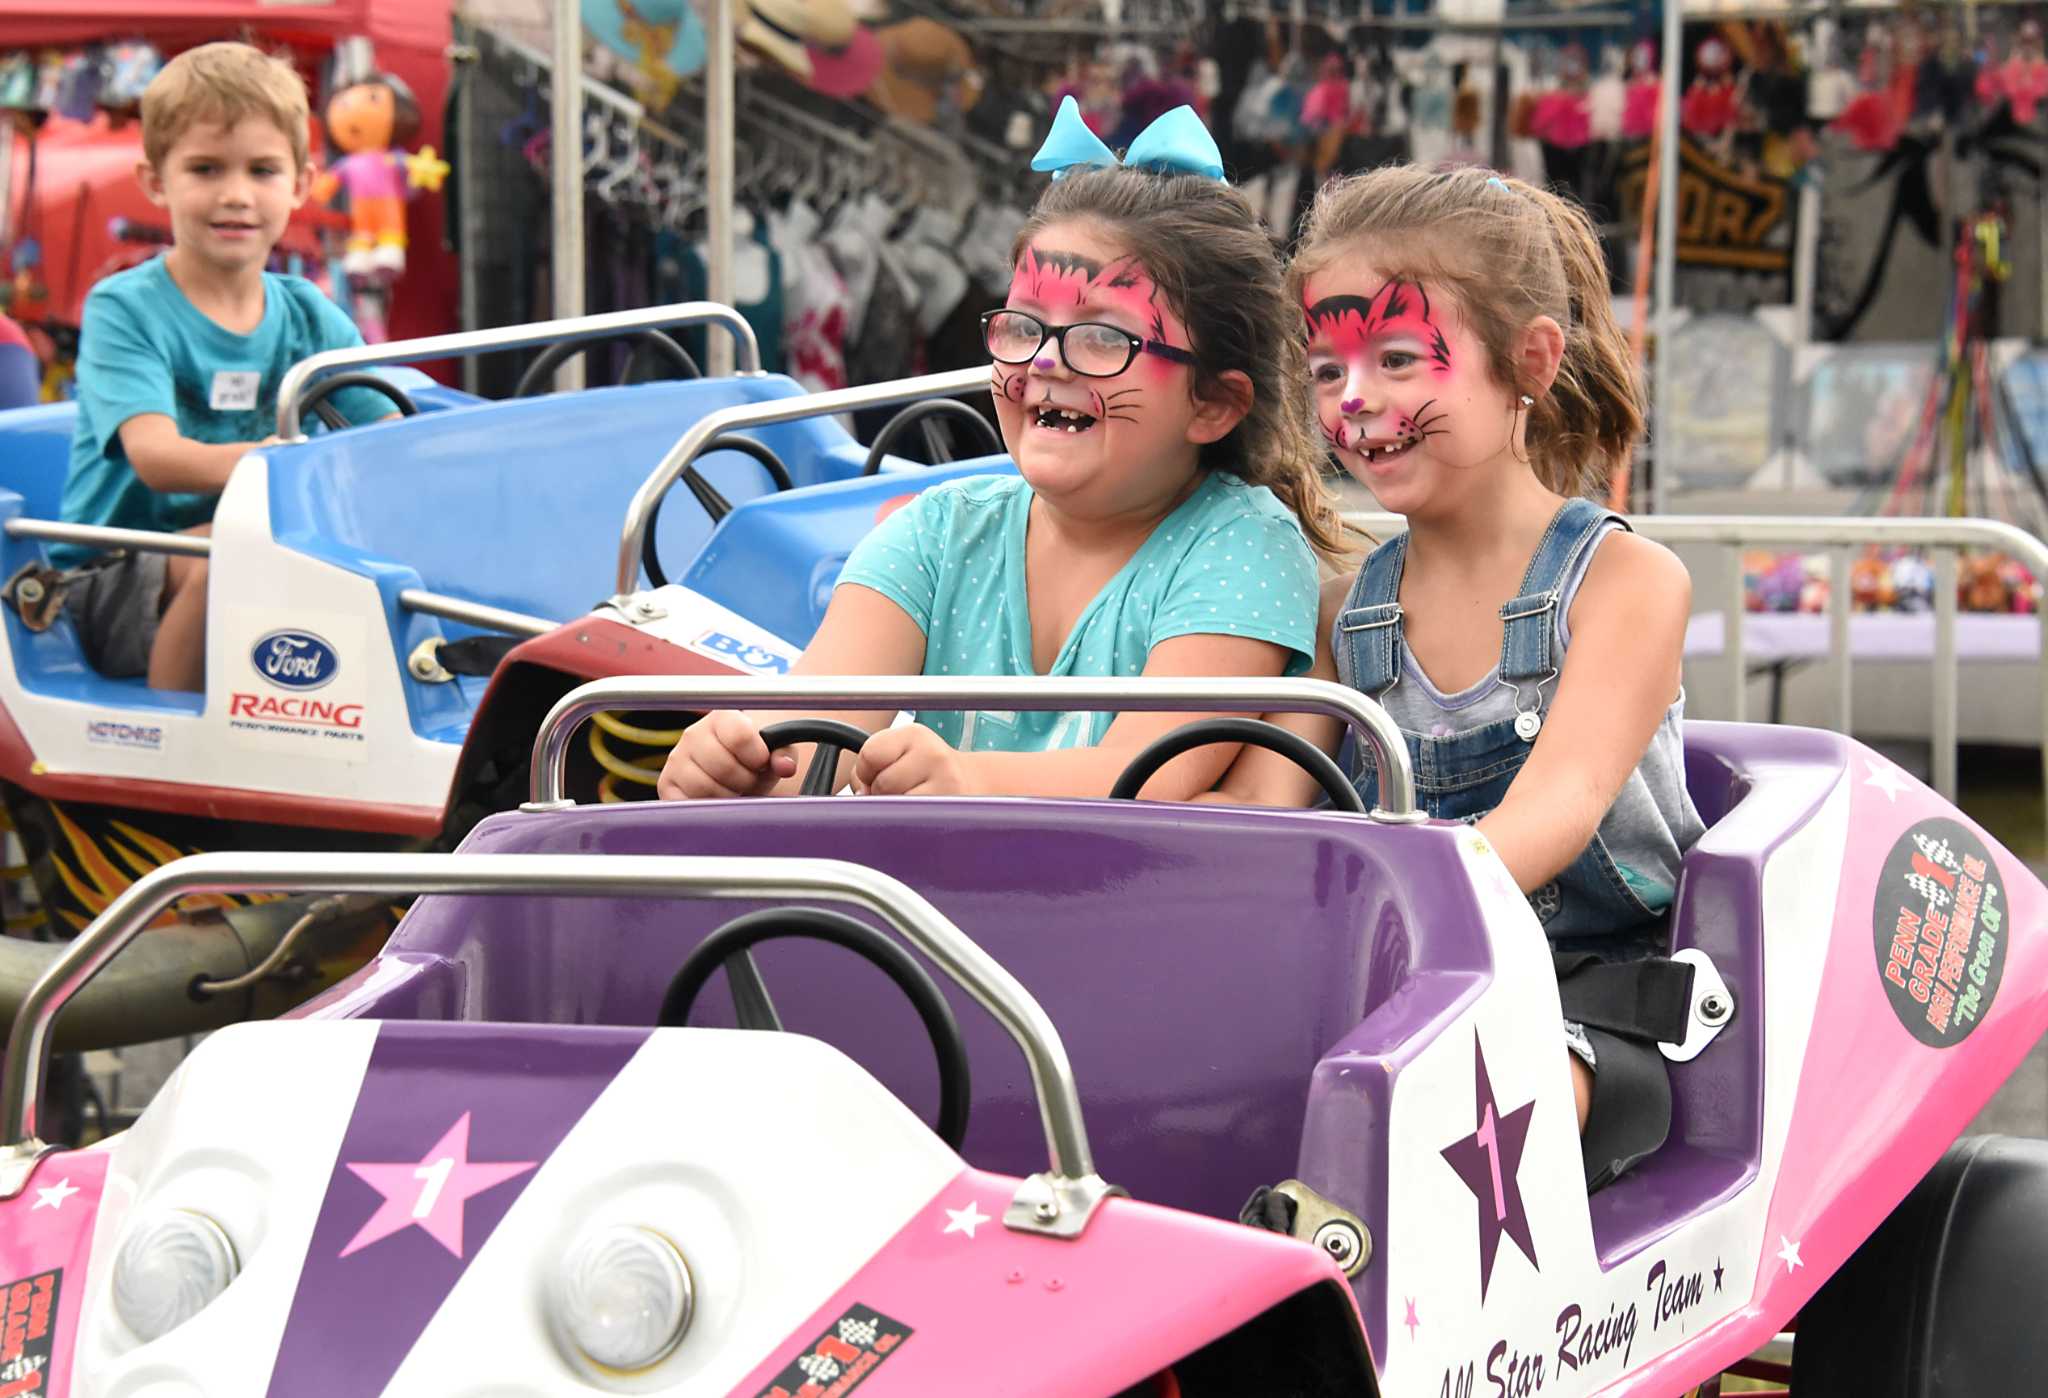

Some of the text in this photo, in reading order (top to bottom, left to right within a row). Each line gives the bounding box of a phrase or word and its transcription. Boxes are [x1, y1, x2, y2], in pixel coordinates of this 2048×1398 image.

[266, 636, 322, 679] Ford
[230, 693, 364, 728] RACING
[230, 720, 364, 741] PERFORMANCE PARTS
[1884, 906, 1922, 989] PENN
[1908, 908, 1949, 1004] GRADE
[1926, 853, 1987, 1035] HIGH PERFORMANCE OIL
[1968, 930, 1996, 986] Green
[412, 1157, 455, 1218] 1
[1477, 1101, 1507, 1221] 1
[1486, 1339, 1545, 1398] Star
[1556, 1303, 1639, 1381] Racing
[1647, 1259, 1704, 1332] Team
